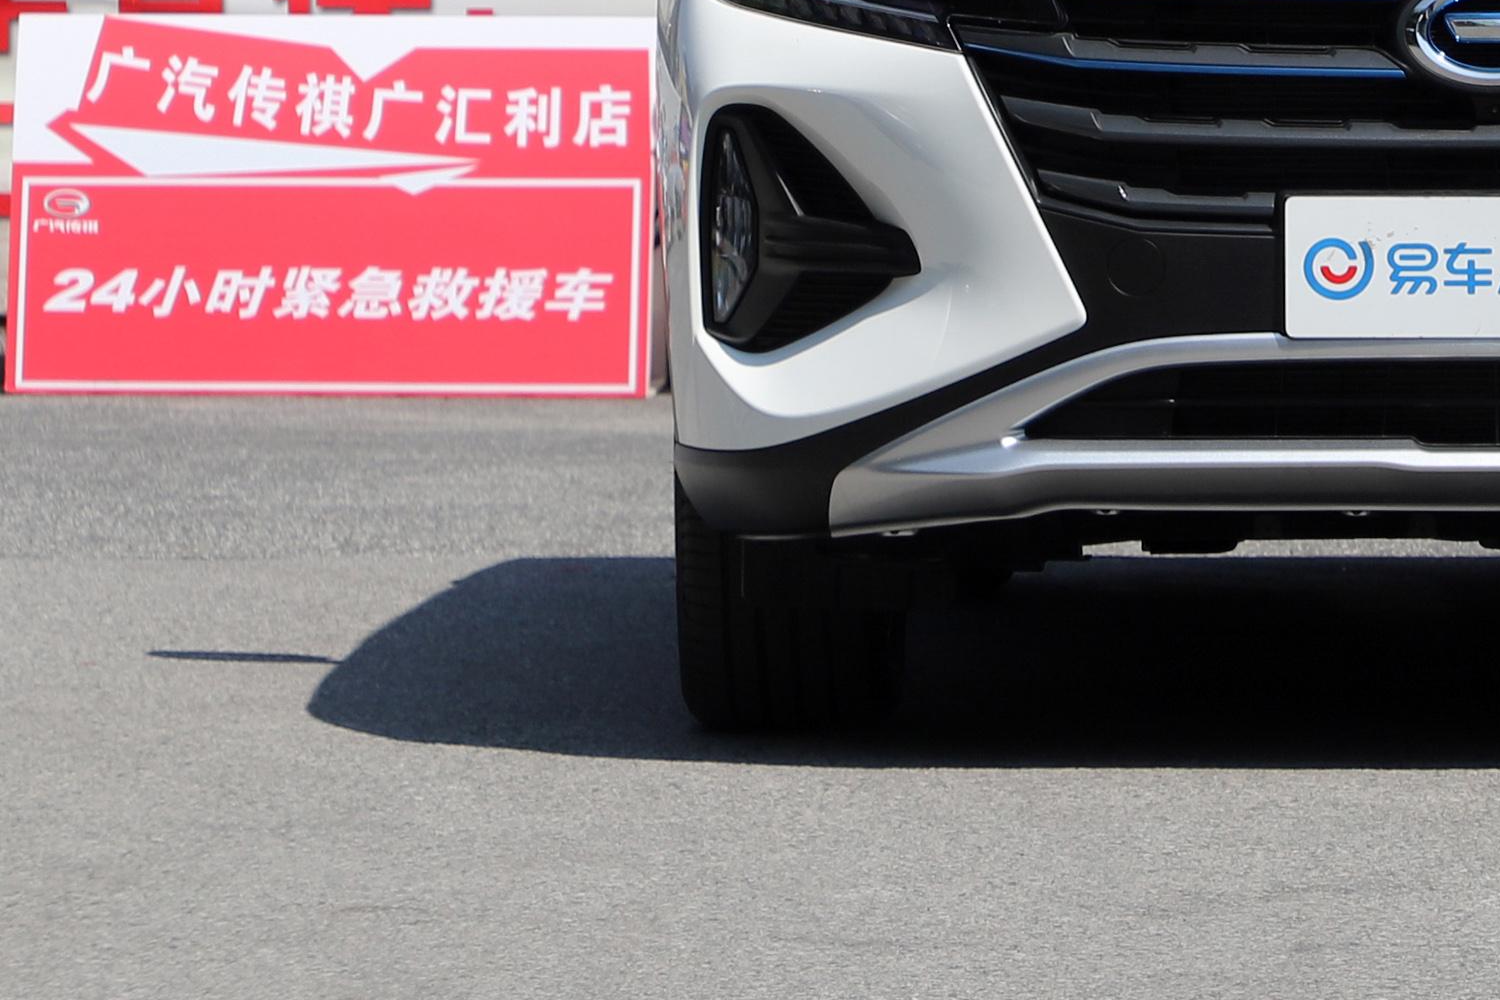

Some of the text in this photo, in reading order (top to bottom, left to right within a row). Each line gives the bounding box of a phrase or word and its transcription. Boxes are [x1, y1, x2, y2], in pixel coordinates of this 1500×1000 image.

[86, 46, 632, 148] 广汽传祺广汇利店
[42, 265, 614, 321] 24小时紧急救援车
